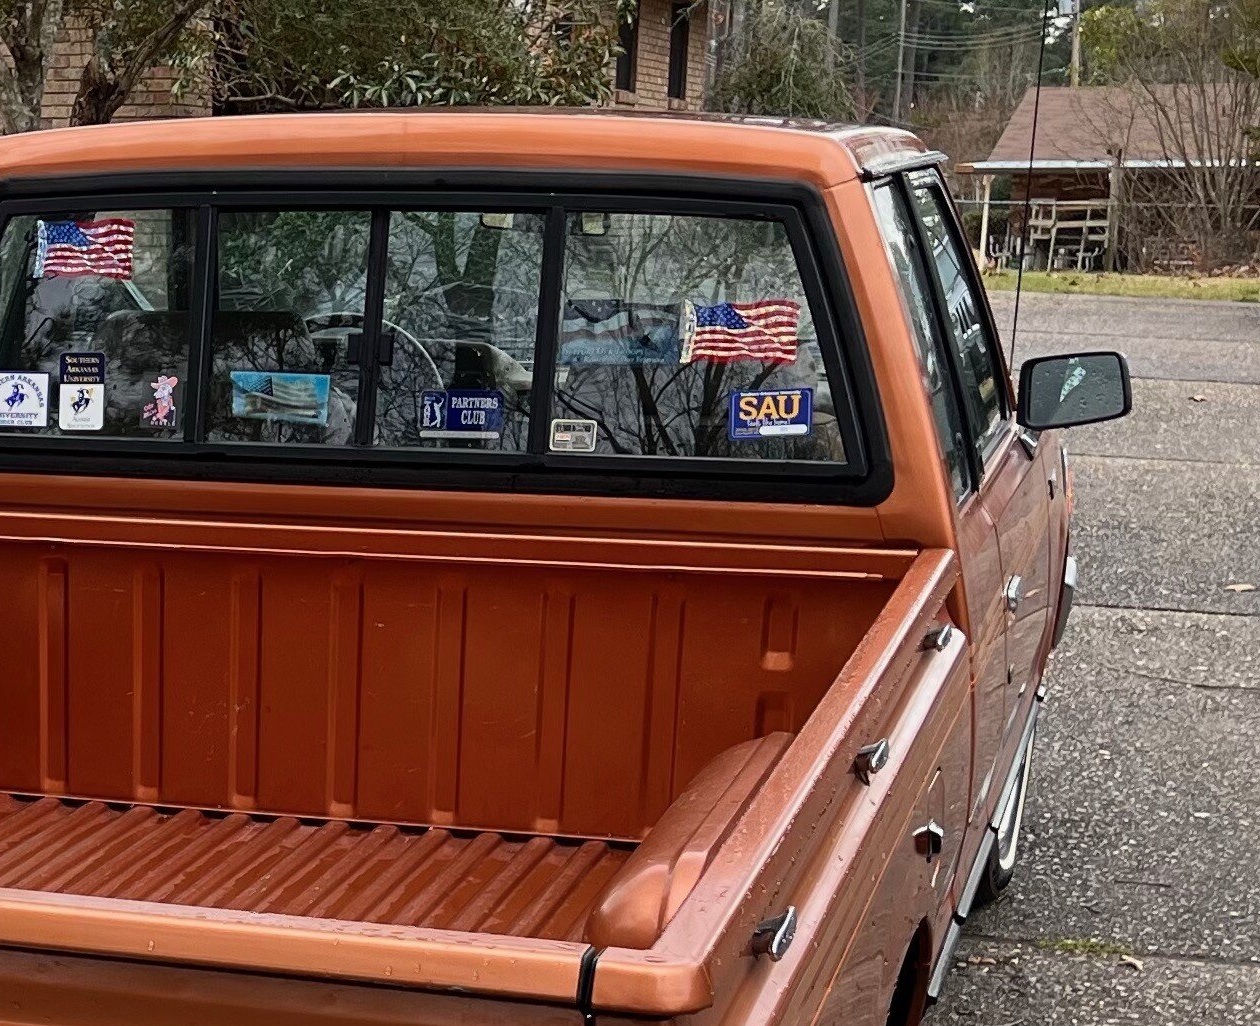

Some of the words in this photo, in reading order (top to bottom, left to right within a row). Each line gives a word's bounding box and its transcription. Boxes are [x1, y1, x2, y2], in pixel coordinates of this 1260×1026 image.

[451, 396, 499, 409] PARTNERS
[739, 394, 802, 421] SAU
[460, 410, 486, 425] CLUB
